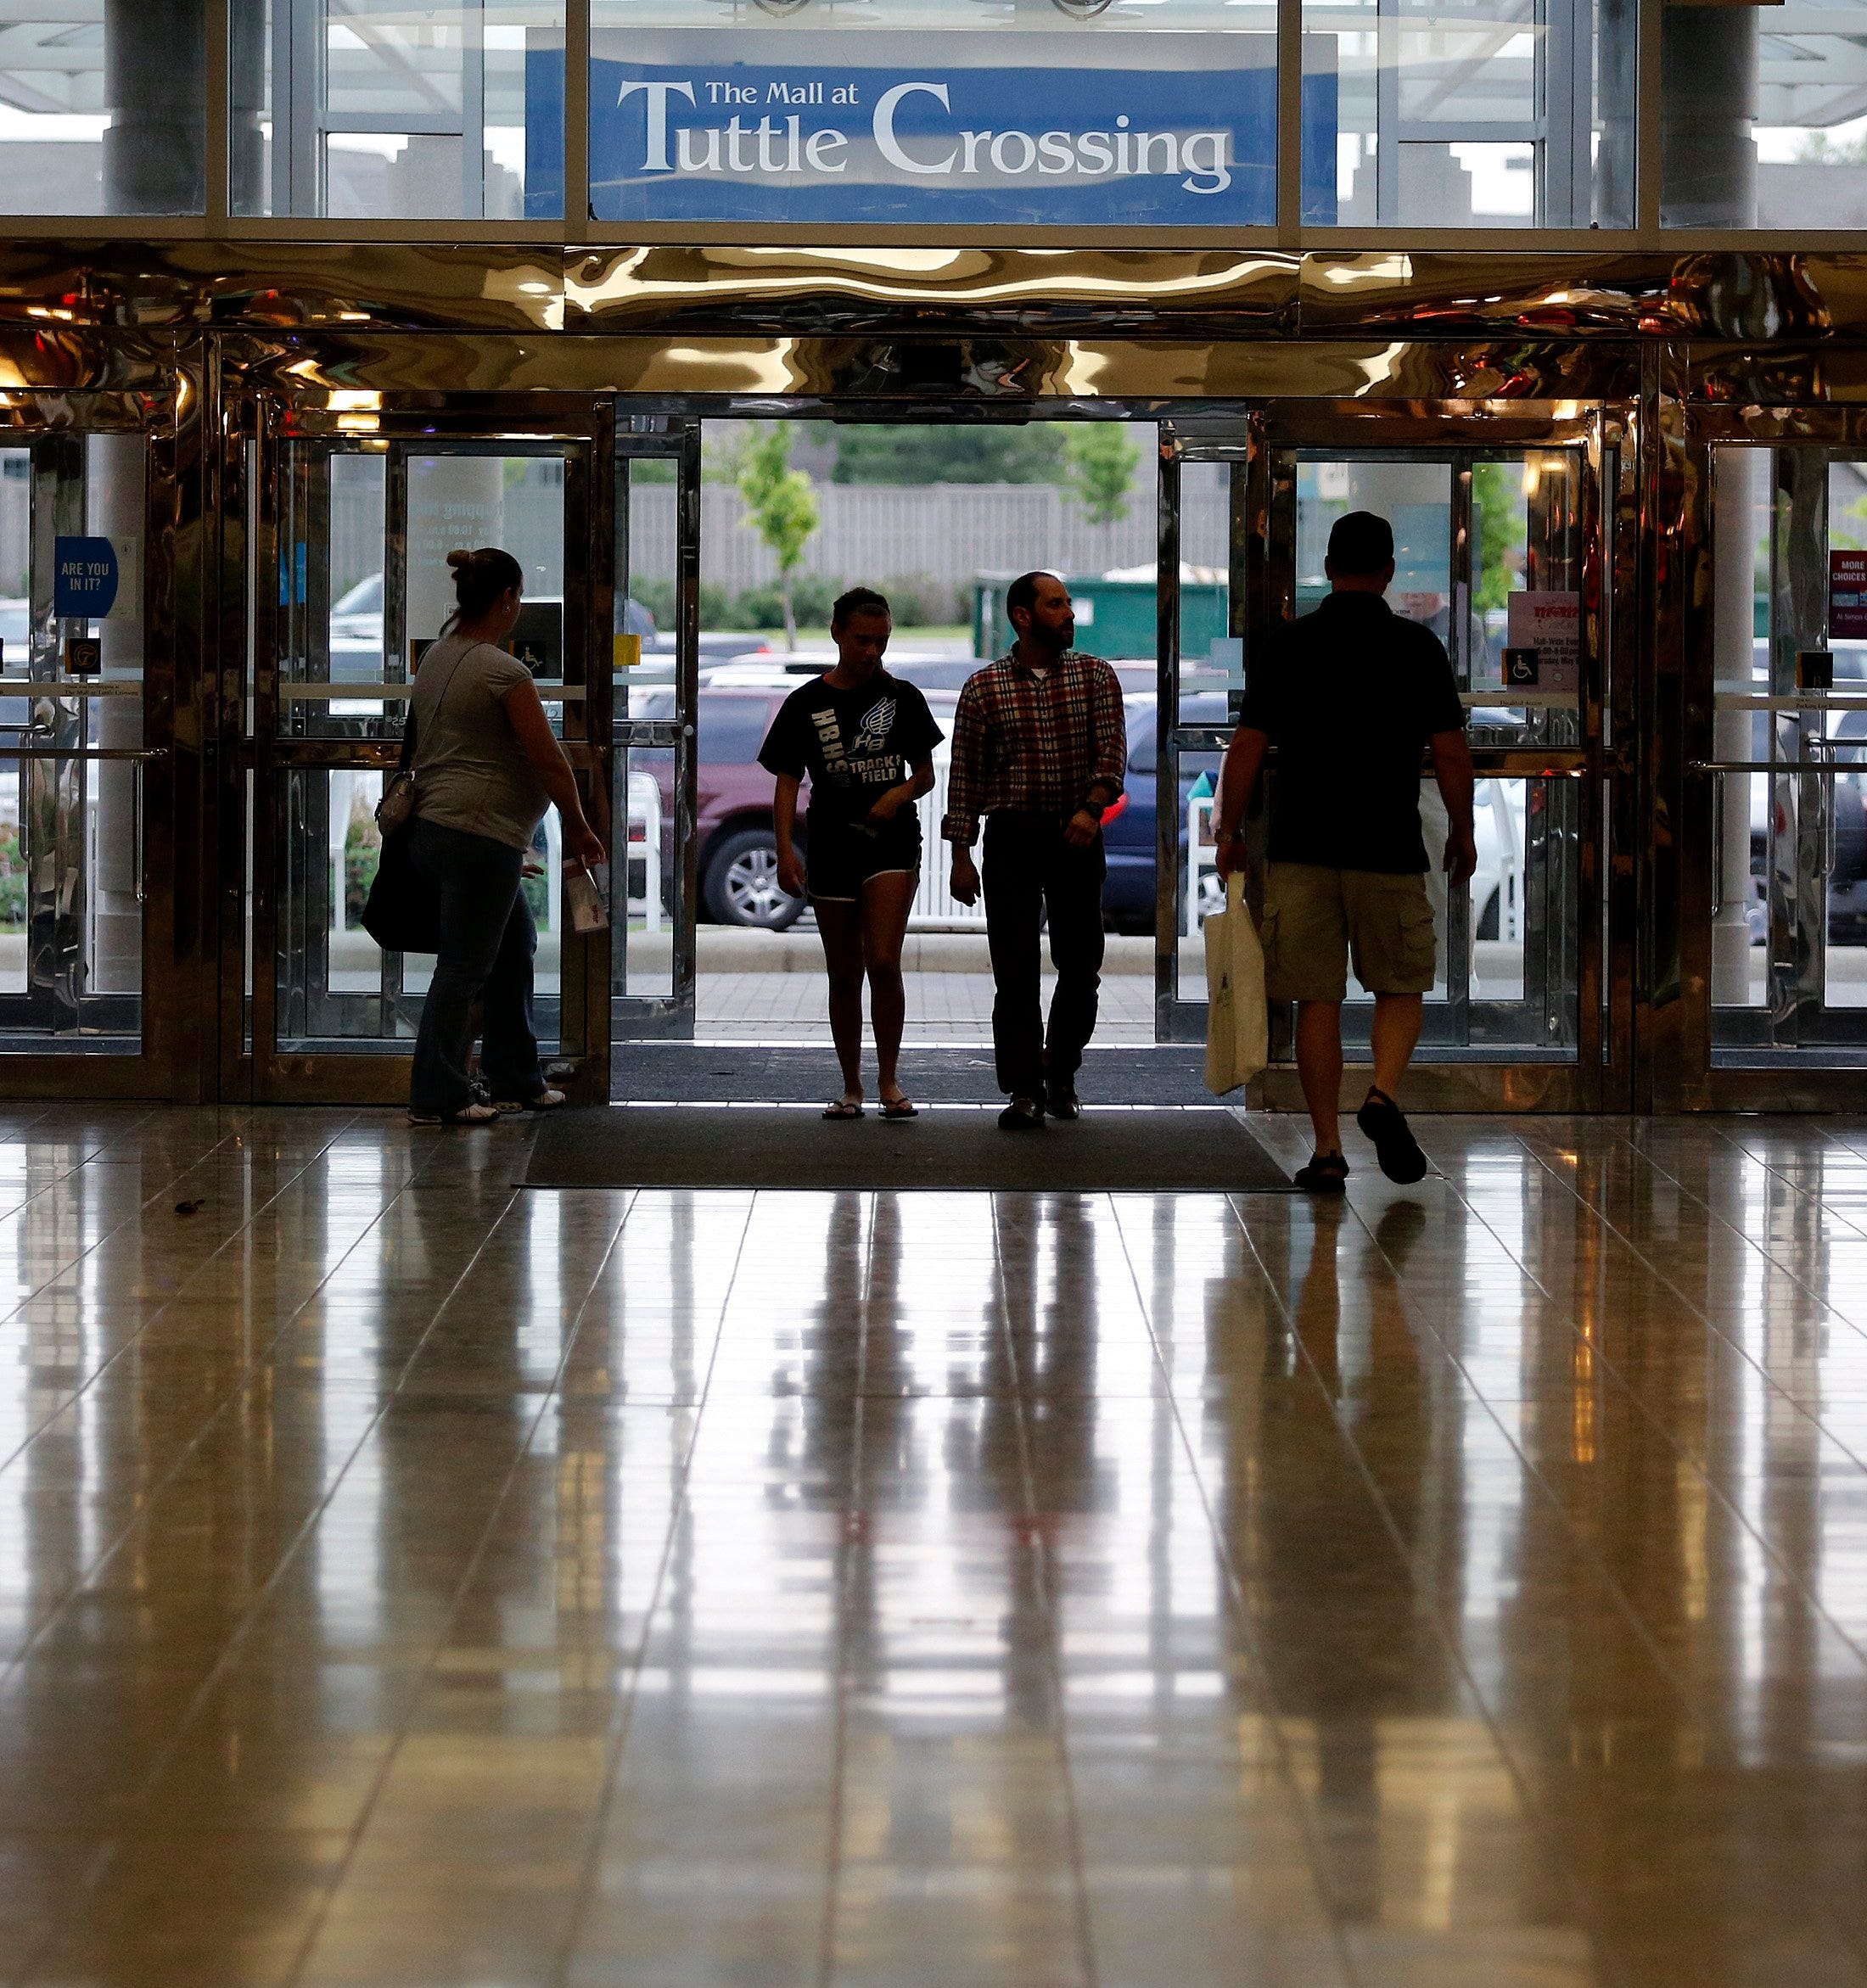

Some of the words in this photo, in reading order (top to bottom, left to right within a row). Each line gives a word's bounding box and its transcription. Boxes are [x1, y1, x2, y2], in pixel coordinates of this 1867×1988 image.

[704, 81, 758, 104] The
[767, 81, 823, 104] Mall
[832, 83, 860, 104] at
[617, 80, 848, 172] Tuttle
[872, 81, 1234, 194] Crossing
[61, 562, 84, 575] ARE
[87, 562, 109, 576] YOU
[1841, 560, 1865, 570] MORE
[1832, 571, 1866, 581] CHOICES
[70, 577, 81, 591] IN
[85, 578, 101, 591] IT?
[849, 754, 894, 774] TRACK
[861, 768, 897, 784] FIELD
